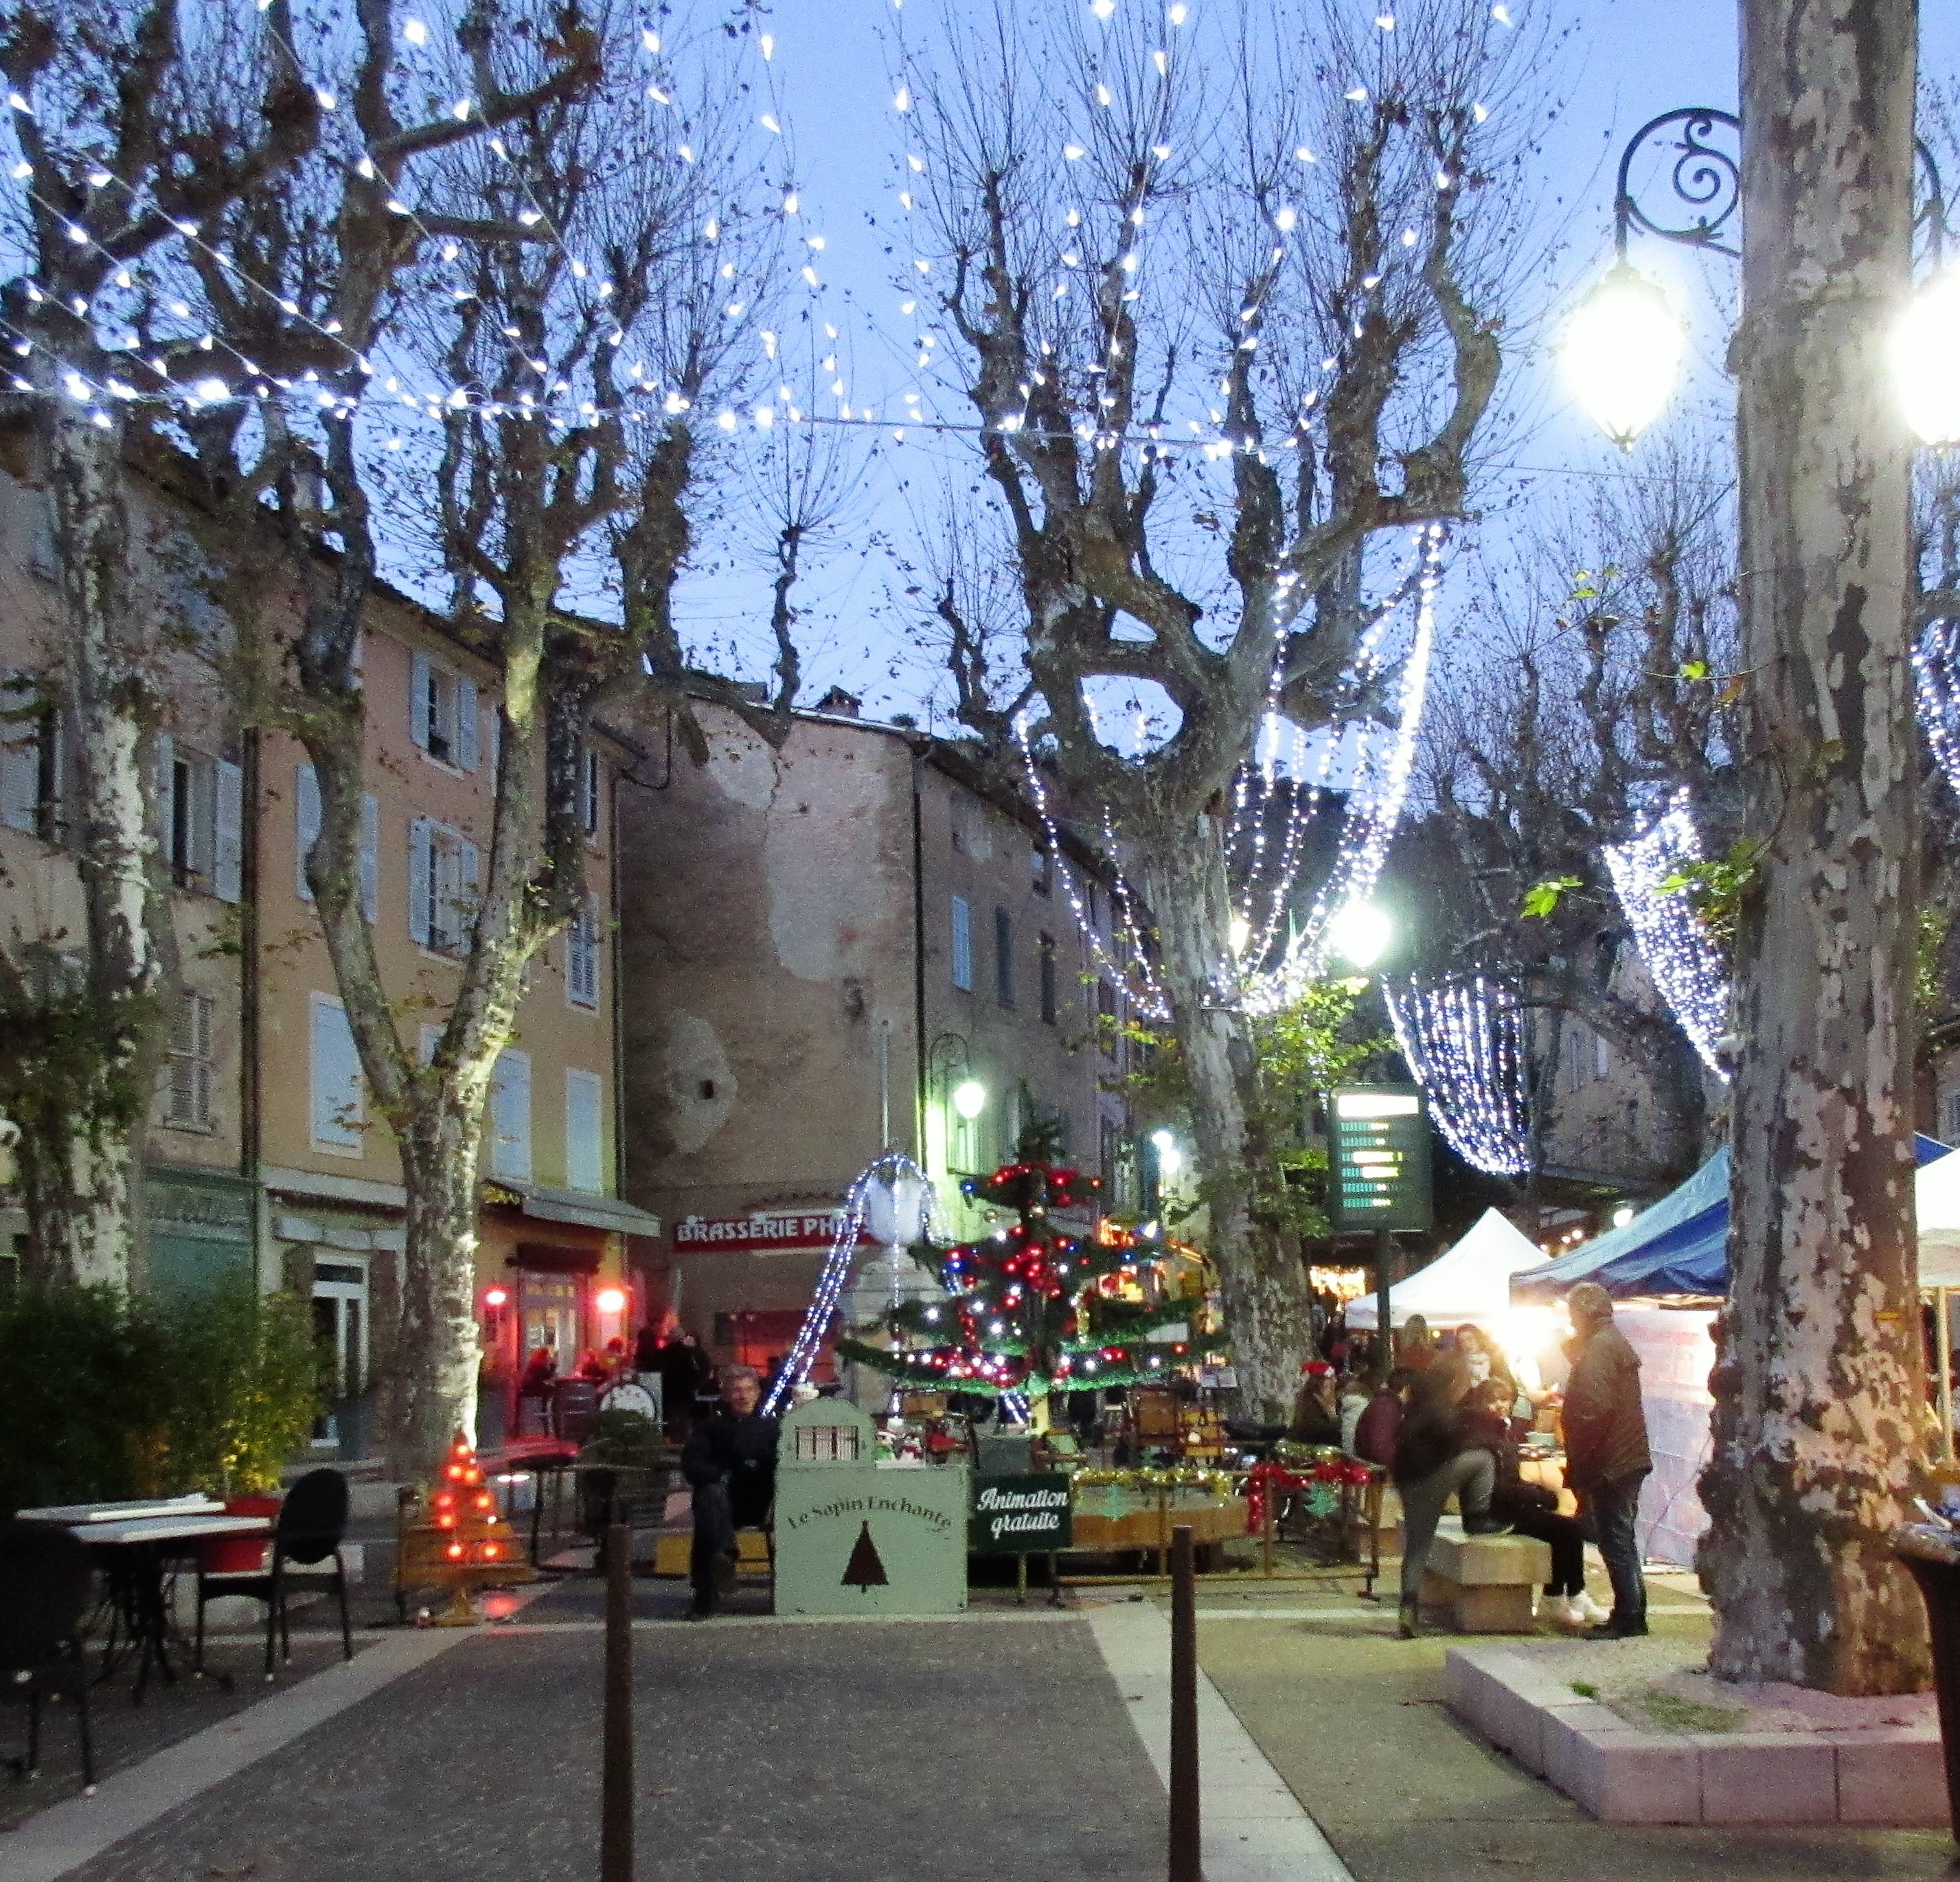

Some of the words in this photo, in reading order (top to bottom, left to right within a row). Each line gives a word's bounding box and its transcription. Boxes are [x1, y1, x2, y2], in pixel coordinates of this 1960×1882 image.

[676, 1219, 798, 1242] BRASSERIE
[977, 1487, 1069, 1510] Animation
[787, 1513, 809, 1530] Le
[812, 1497, 863, 1517] Sapin
[990, 1512, 1060, 1540] gratuite
